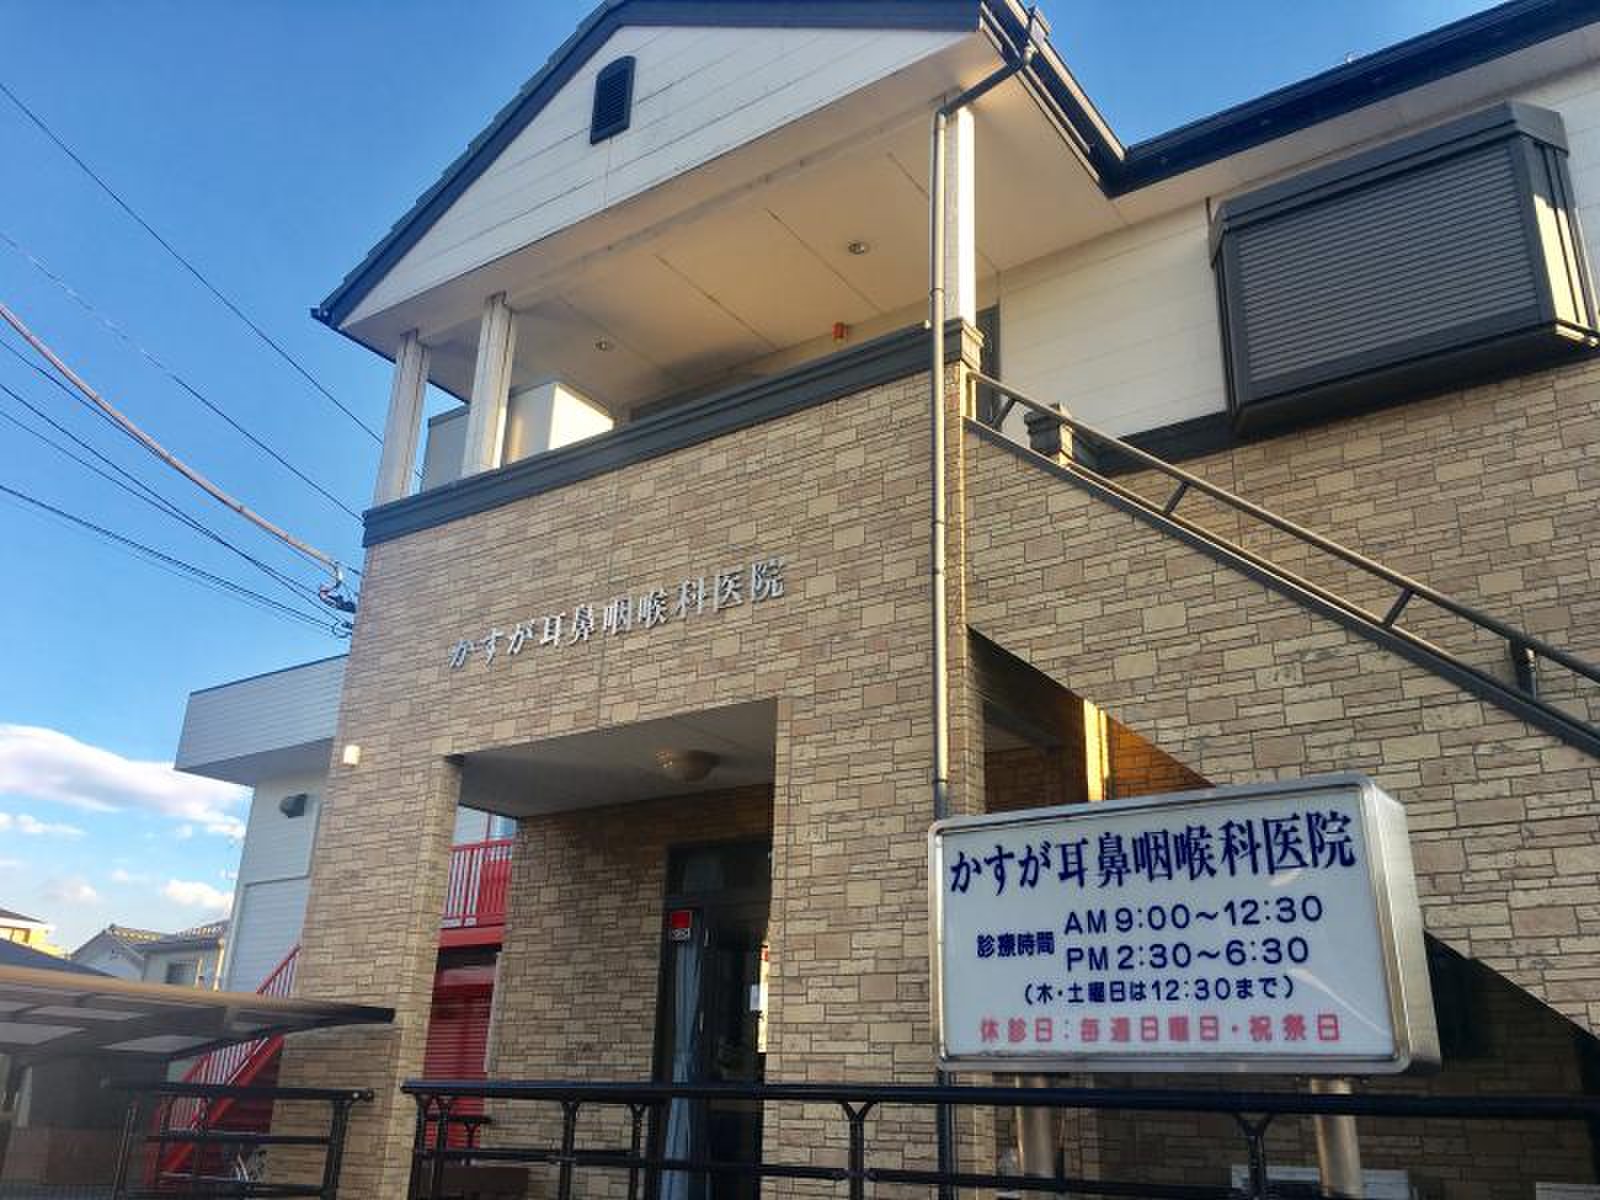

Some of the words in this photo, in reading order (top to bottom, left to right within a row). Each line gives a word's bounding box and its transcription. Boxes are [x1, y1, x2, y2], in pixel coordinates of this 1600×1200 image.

[448, 558, 786, 668] かすが耳鼻咽喉科医院
[950, 811, 1356, 895] かすが耳鼻咽喉科医院
[976, 931, 1056, 958] 診療時間
